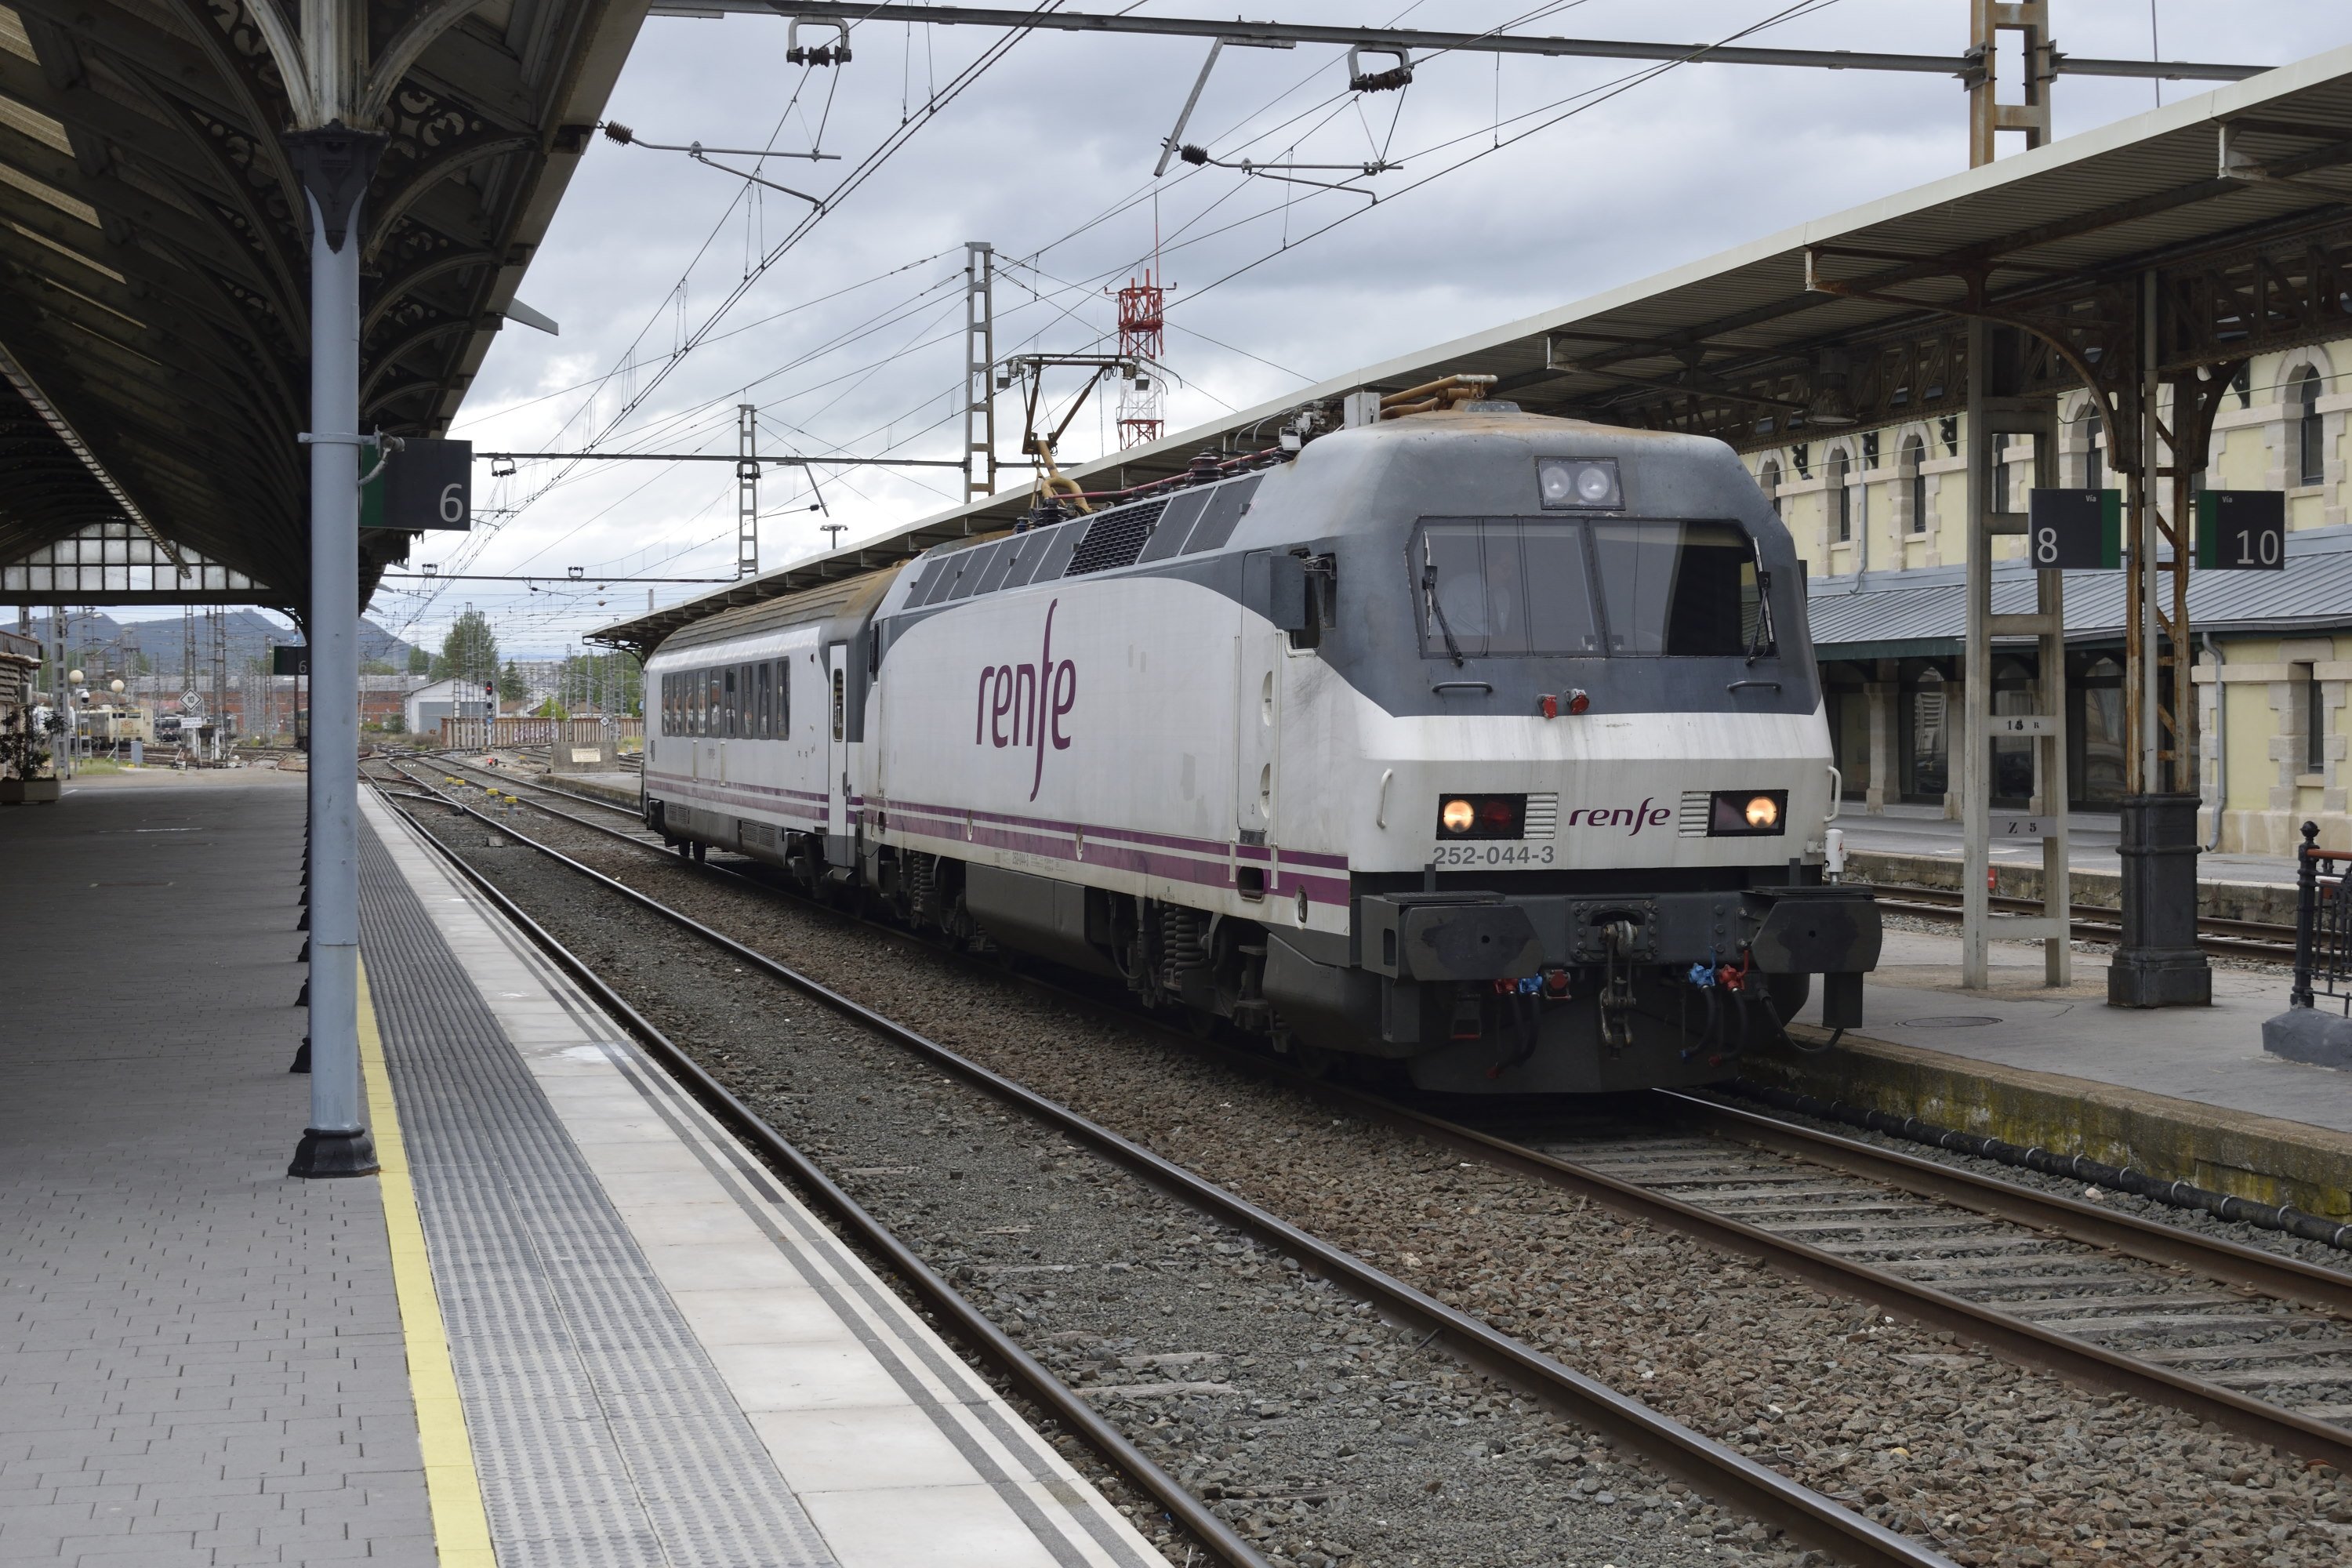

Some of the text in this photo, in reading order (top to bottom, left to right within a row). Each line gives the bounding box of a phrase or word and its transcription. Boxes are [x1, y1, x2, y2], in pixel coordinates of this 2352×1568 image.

[440, 483, 463, 523] 6
[2038, 527, 2058, 563] 8
[2237, 529, 2279, 565] 10
[299, 660, 307, 673] 6
[976, 598, 1076, 802] renfe
[1569, 797, 1671, 837] renfe
[1433, 846, 1555, 865] 252-044-3
